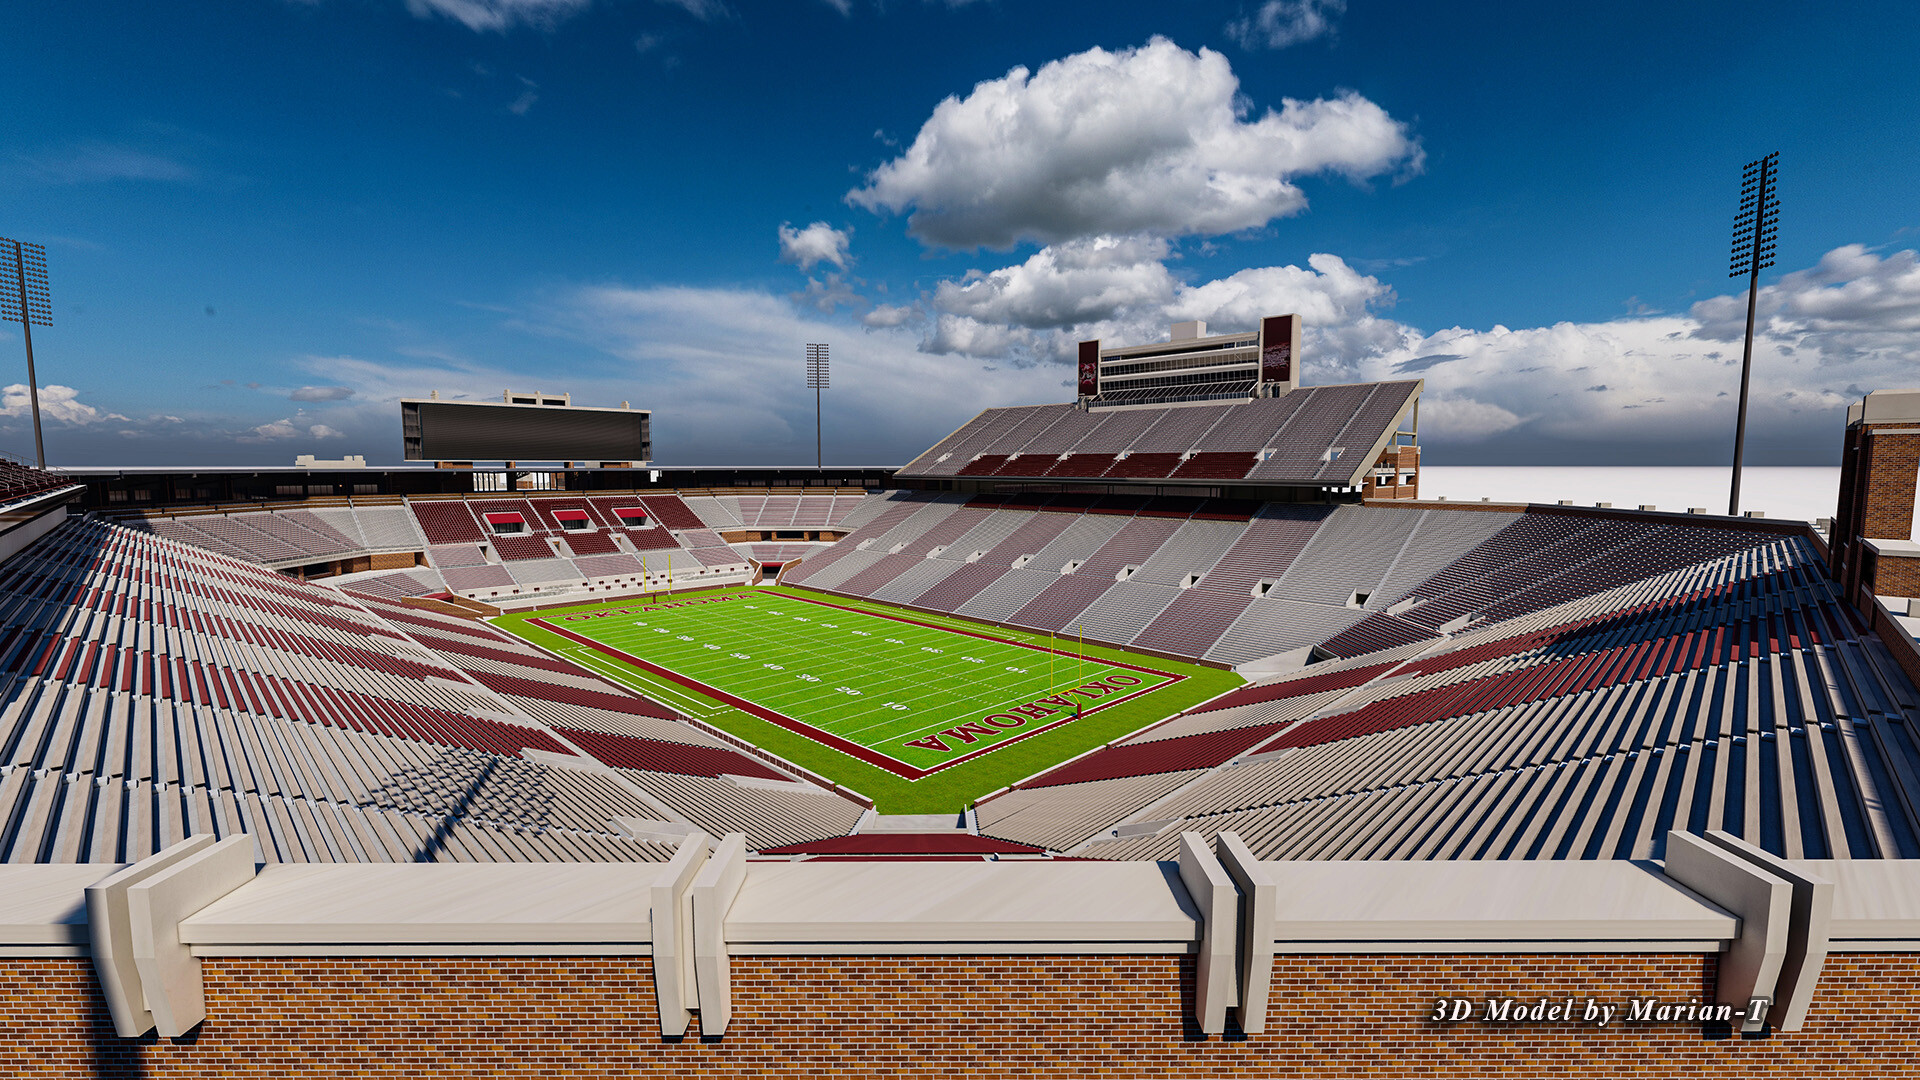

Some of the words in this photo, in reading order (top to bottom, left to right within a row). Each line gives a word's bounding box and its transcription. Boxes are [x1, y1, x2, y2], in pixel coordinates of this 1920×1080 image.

[564, 594, 759, 621] OKLAHOMA
[882, 701, 908, 711] 10
[903, 675, 1142, 753] OKLAHOMA
